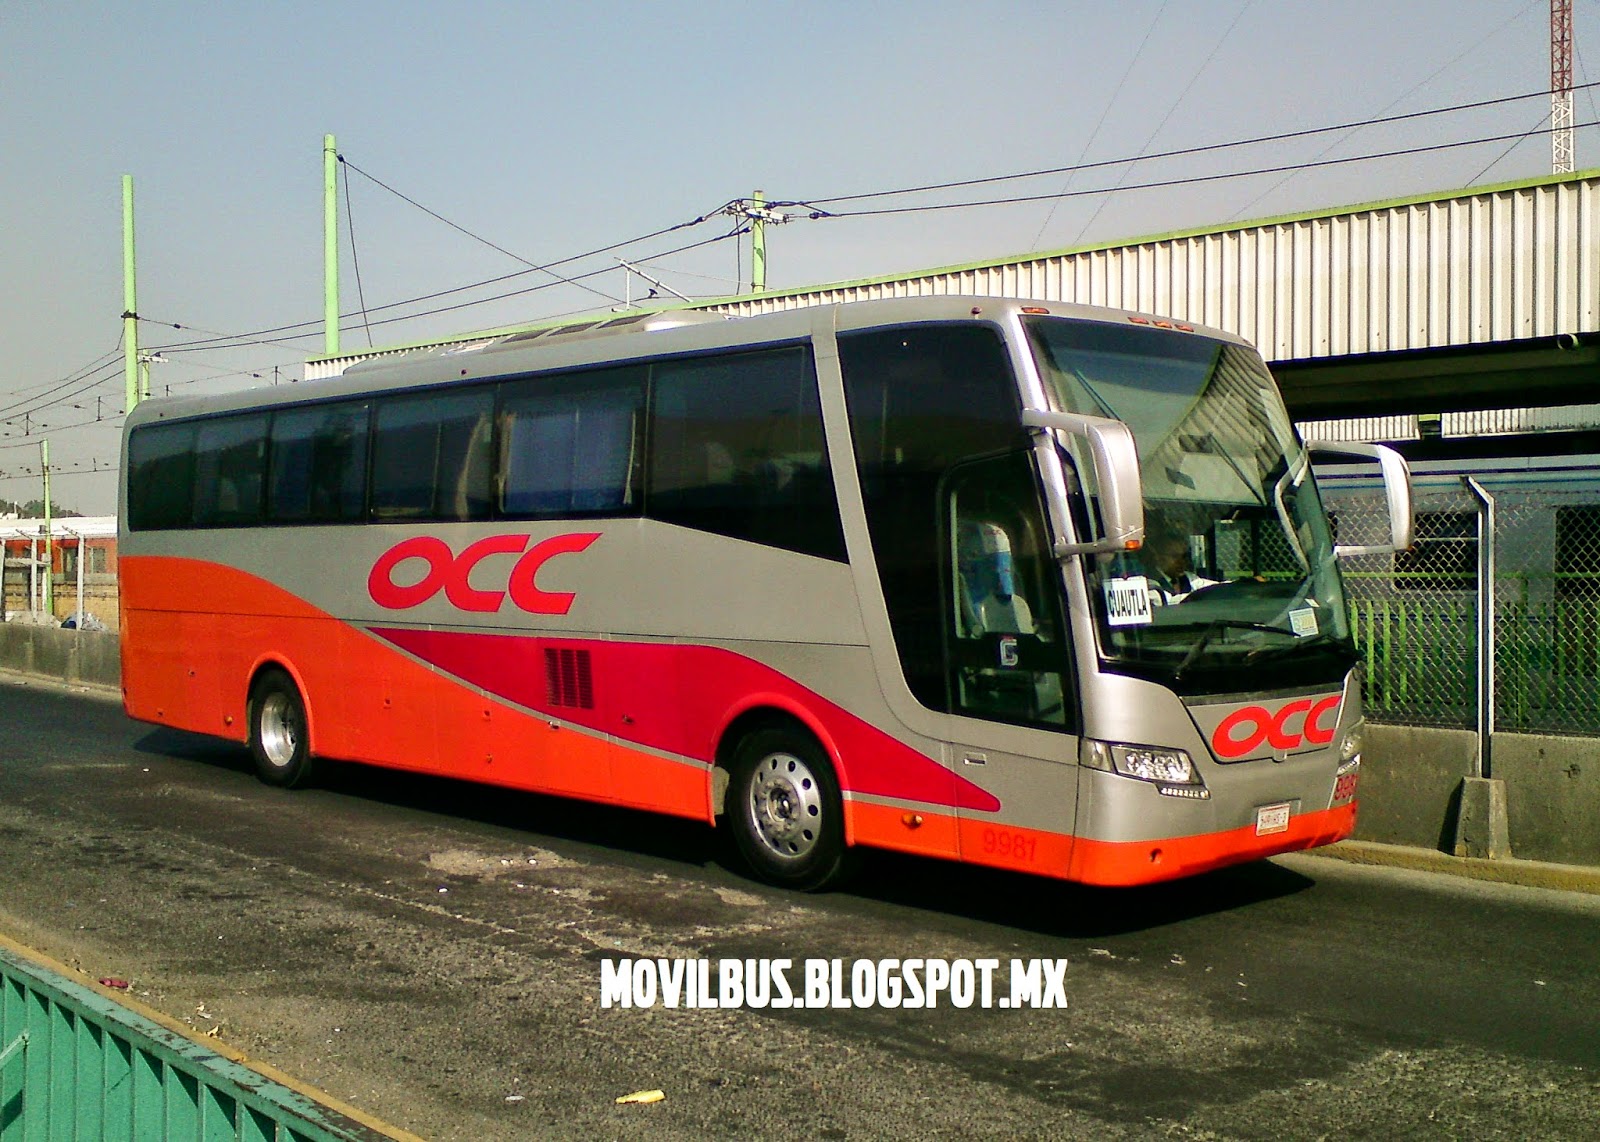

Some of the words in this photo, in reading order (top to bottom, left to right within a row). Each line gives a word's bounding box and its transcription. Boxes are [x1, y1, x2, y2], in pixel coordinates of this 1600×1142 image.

[368, 532, 603, 615] OCC
[1108, 589, 1148, 618] CUAUTLA
[1212, 695, 1342, 758] OCC
[983, 828, 1036, 861] 9981
